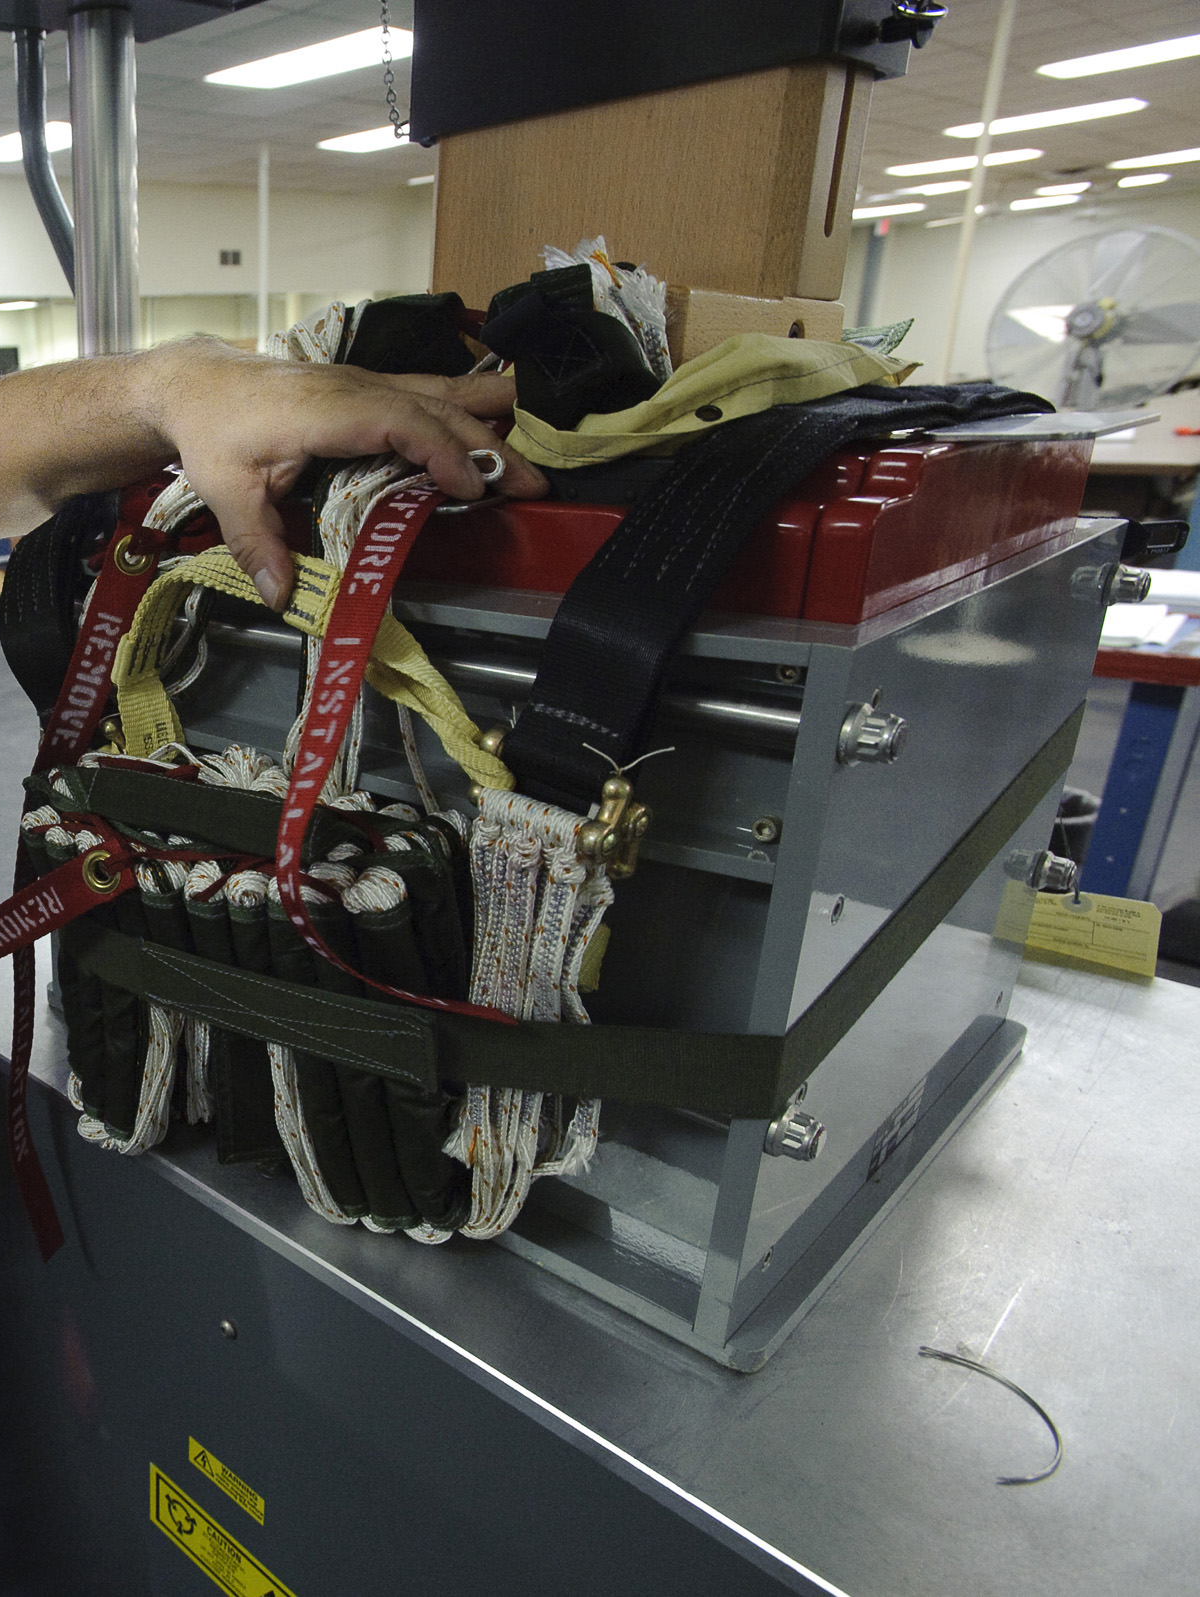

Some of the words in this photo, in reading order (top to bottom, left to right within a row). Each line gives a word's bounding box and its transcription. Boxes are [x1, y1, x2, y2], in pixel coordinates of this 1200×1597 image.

[51, 611, 124, 750] REMOVE
[221, 1465, 259, 1502] WARNING
[206, 1525, 242, 1565] CAUTION
